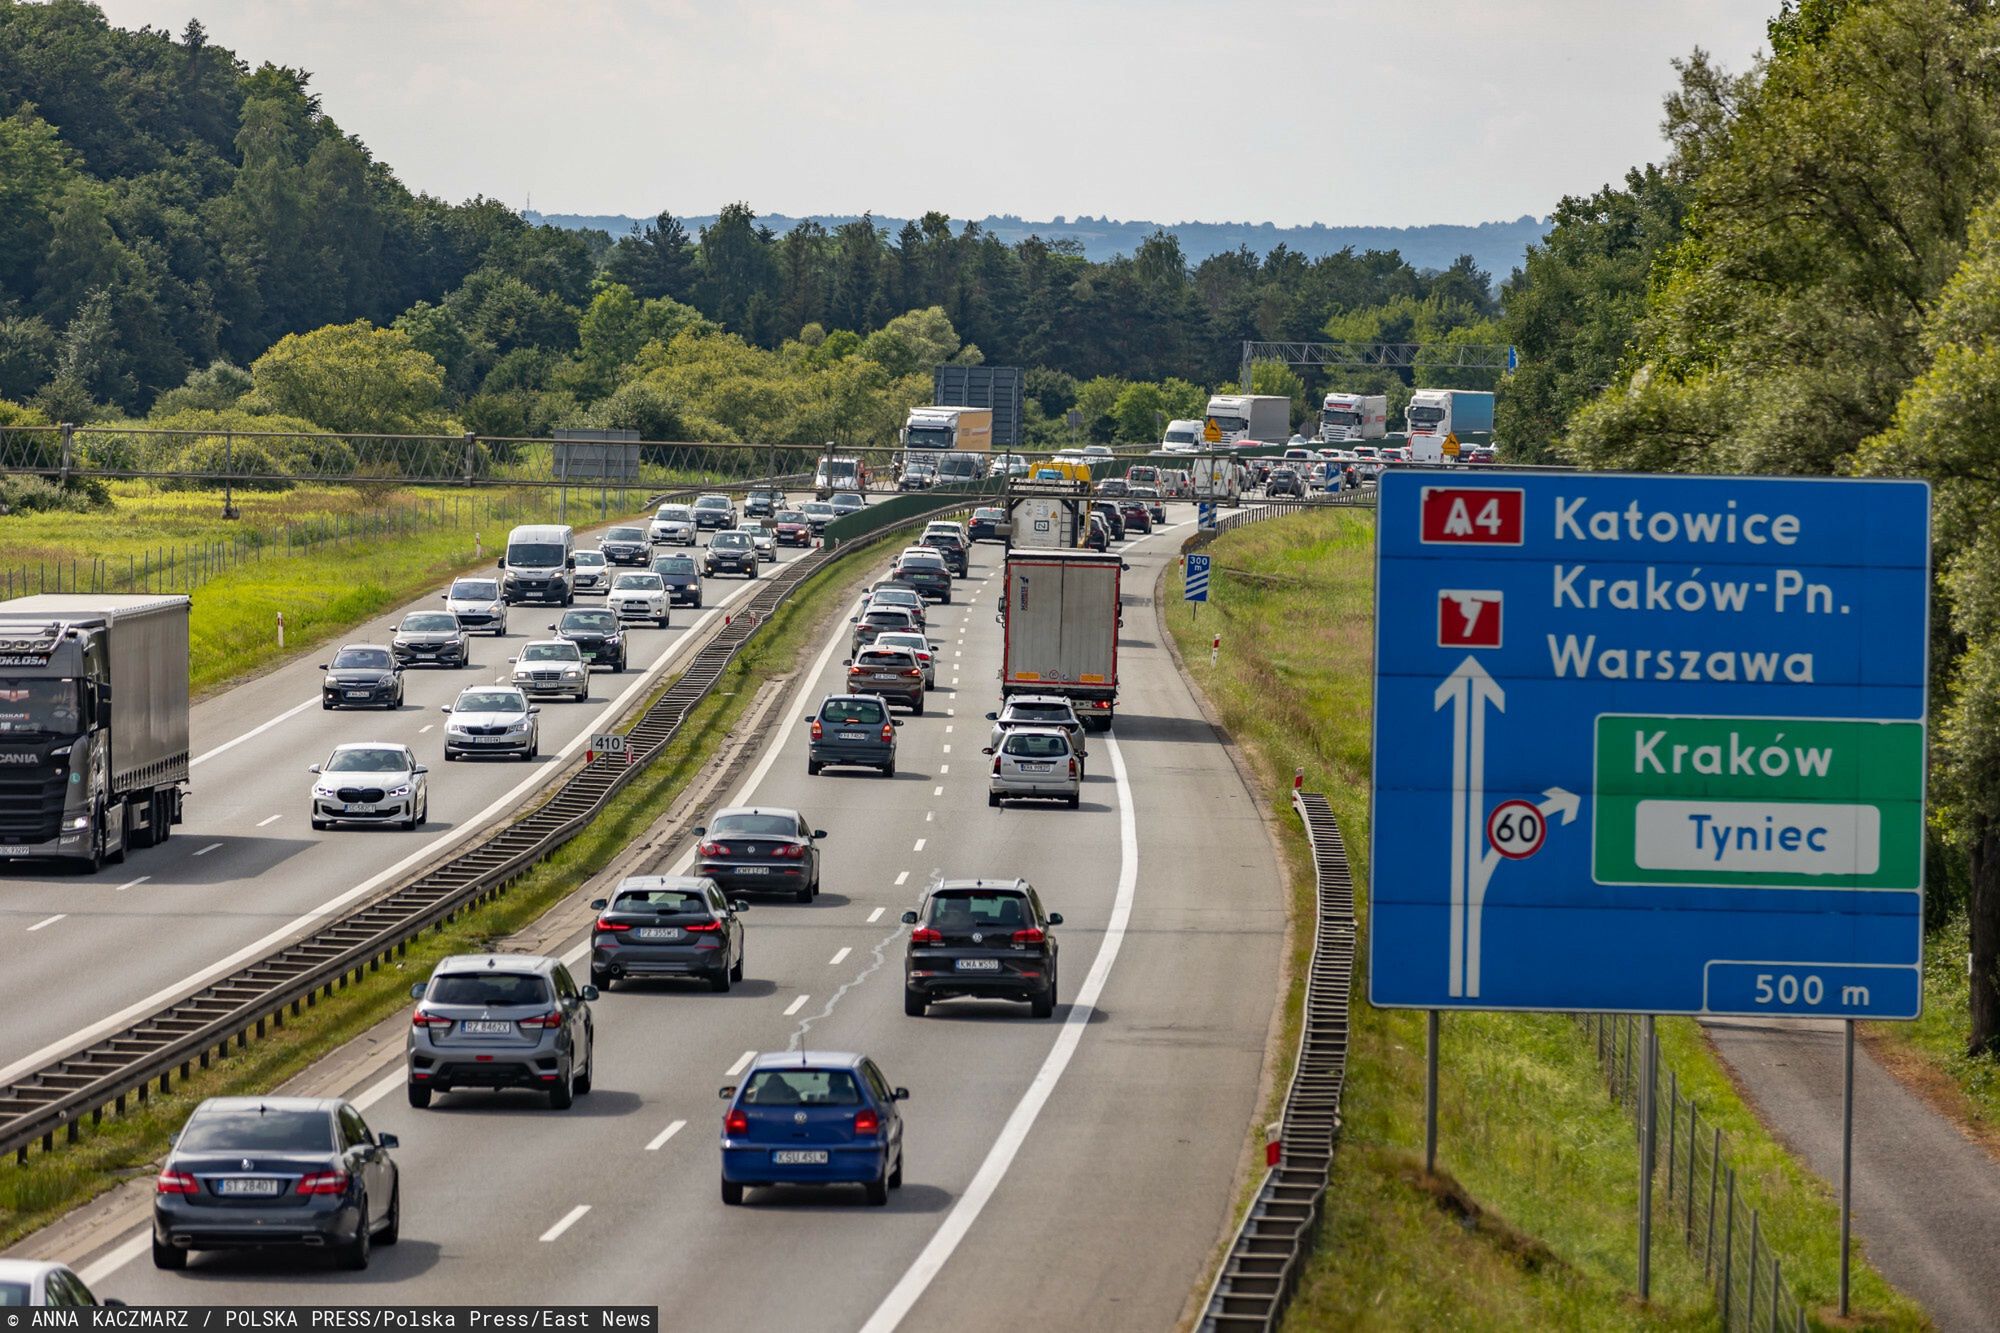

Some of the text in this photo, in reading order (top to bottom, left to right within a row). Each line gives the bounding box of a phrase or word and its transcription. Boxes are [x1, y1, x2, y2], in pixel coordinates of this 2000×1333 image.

[1443, 497, 1502, 536] A4
[1554, 496, 1801, 546] Katowice
[1190, 556, 1208, 566] 300
[1553, 565, 1851, 614] Kraków-Pn.
[1458, 599, 1482, 638] 7
[1547, 634, 1814, 683] Warszawa
[596, 737, 620, 750] 410
[1634, 730, 1833, 777] Kraków
[1496, 814, 1538, 844] 60
[1687, 814, 1828, 860] Tyniec
[1754, 974, 1870, 1006] 500 m
[778, 1151, 800, 1163] KSU
[226, 1180, 275, 1191] ST 2840T
